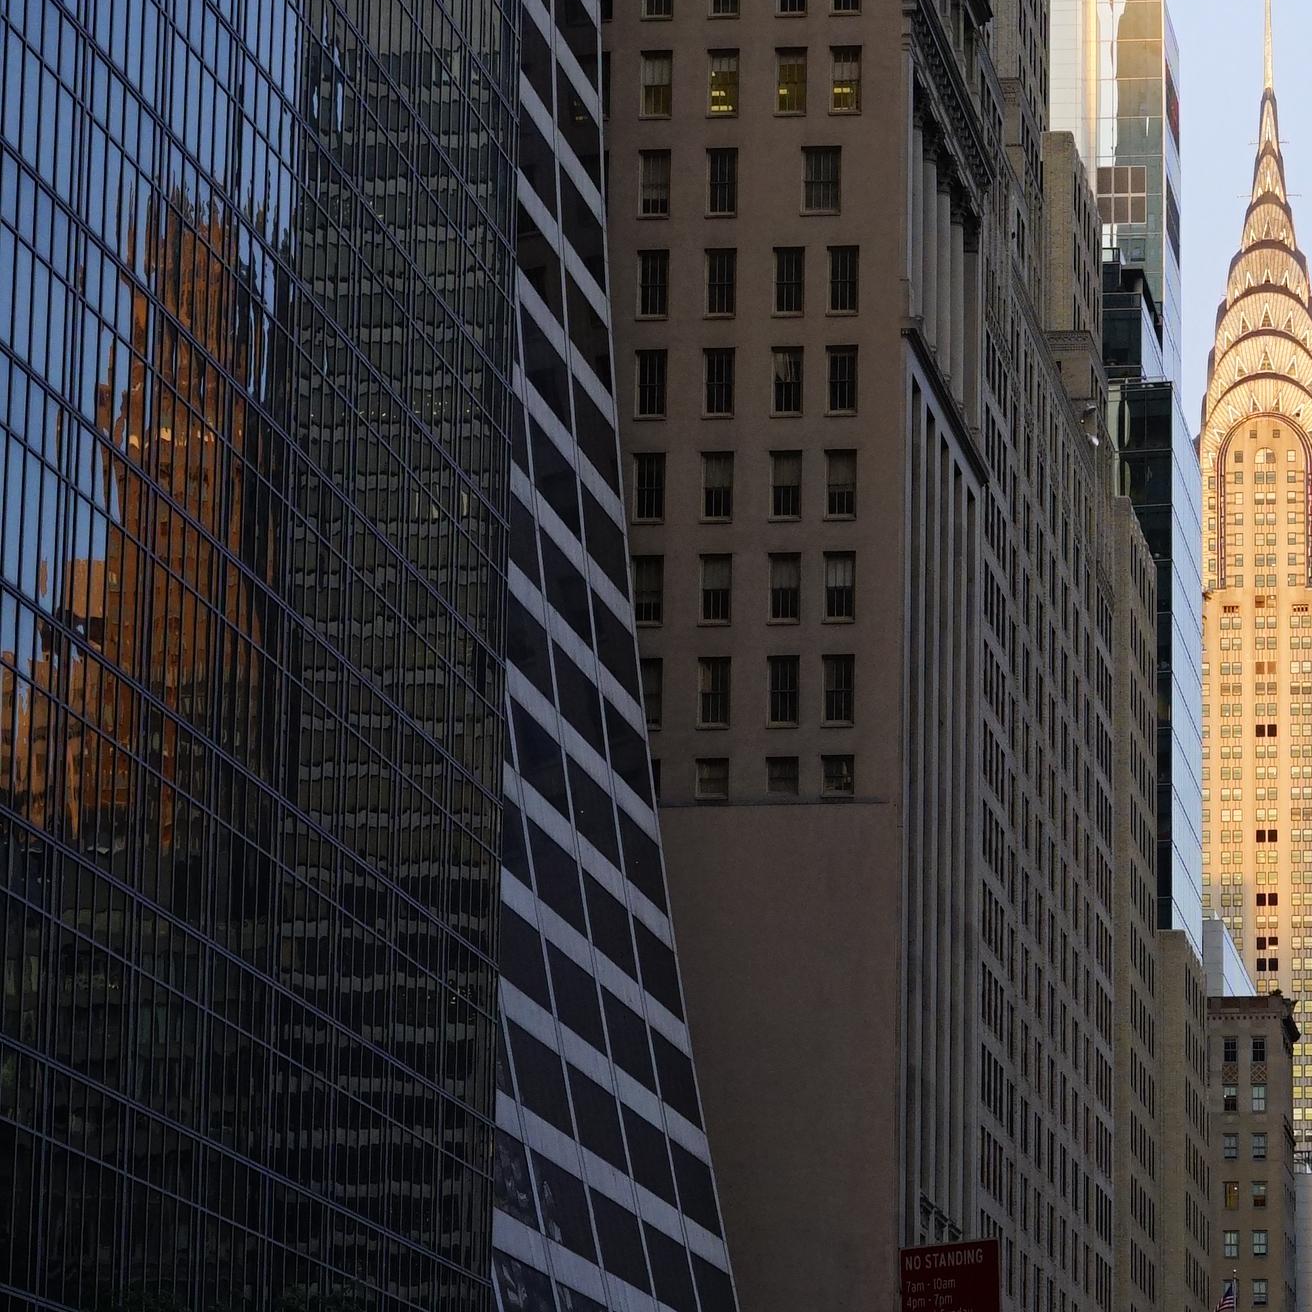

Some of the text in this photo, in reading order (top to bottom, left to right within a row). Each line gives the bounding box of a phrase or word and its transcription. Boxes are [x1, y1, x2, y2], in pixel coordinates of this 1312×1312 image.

[905, 1248, 983, 1271] NO STANDING
[906, 1281, 925, 1293] 7am
[933, 1278, 956, 1290] 10am
[906, 1297, 926, 1310] 4pm
[934, 1293, 953, 1307] 7pm
